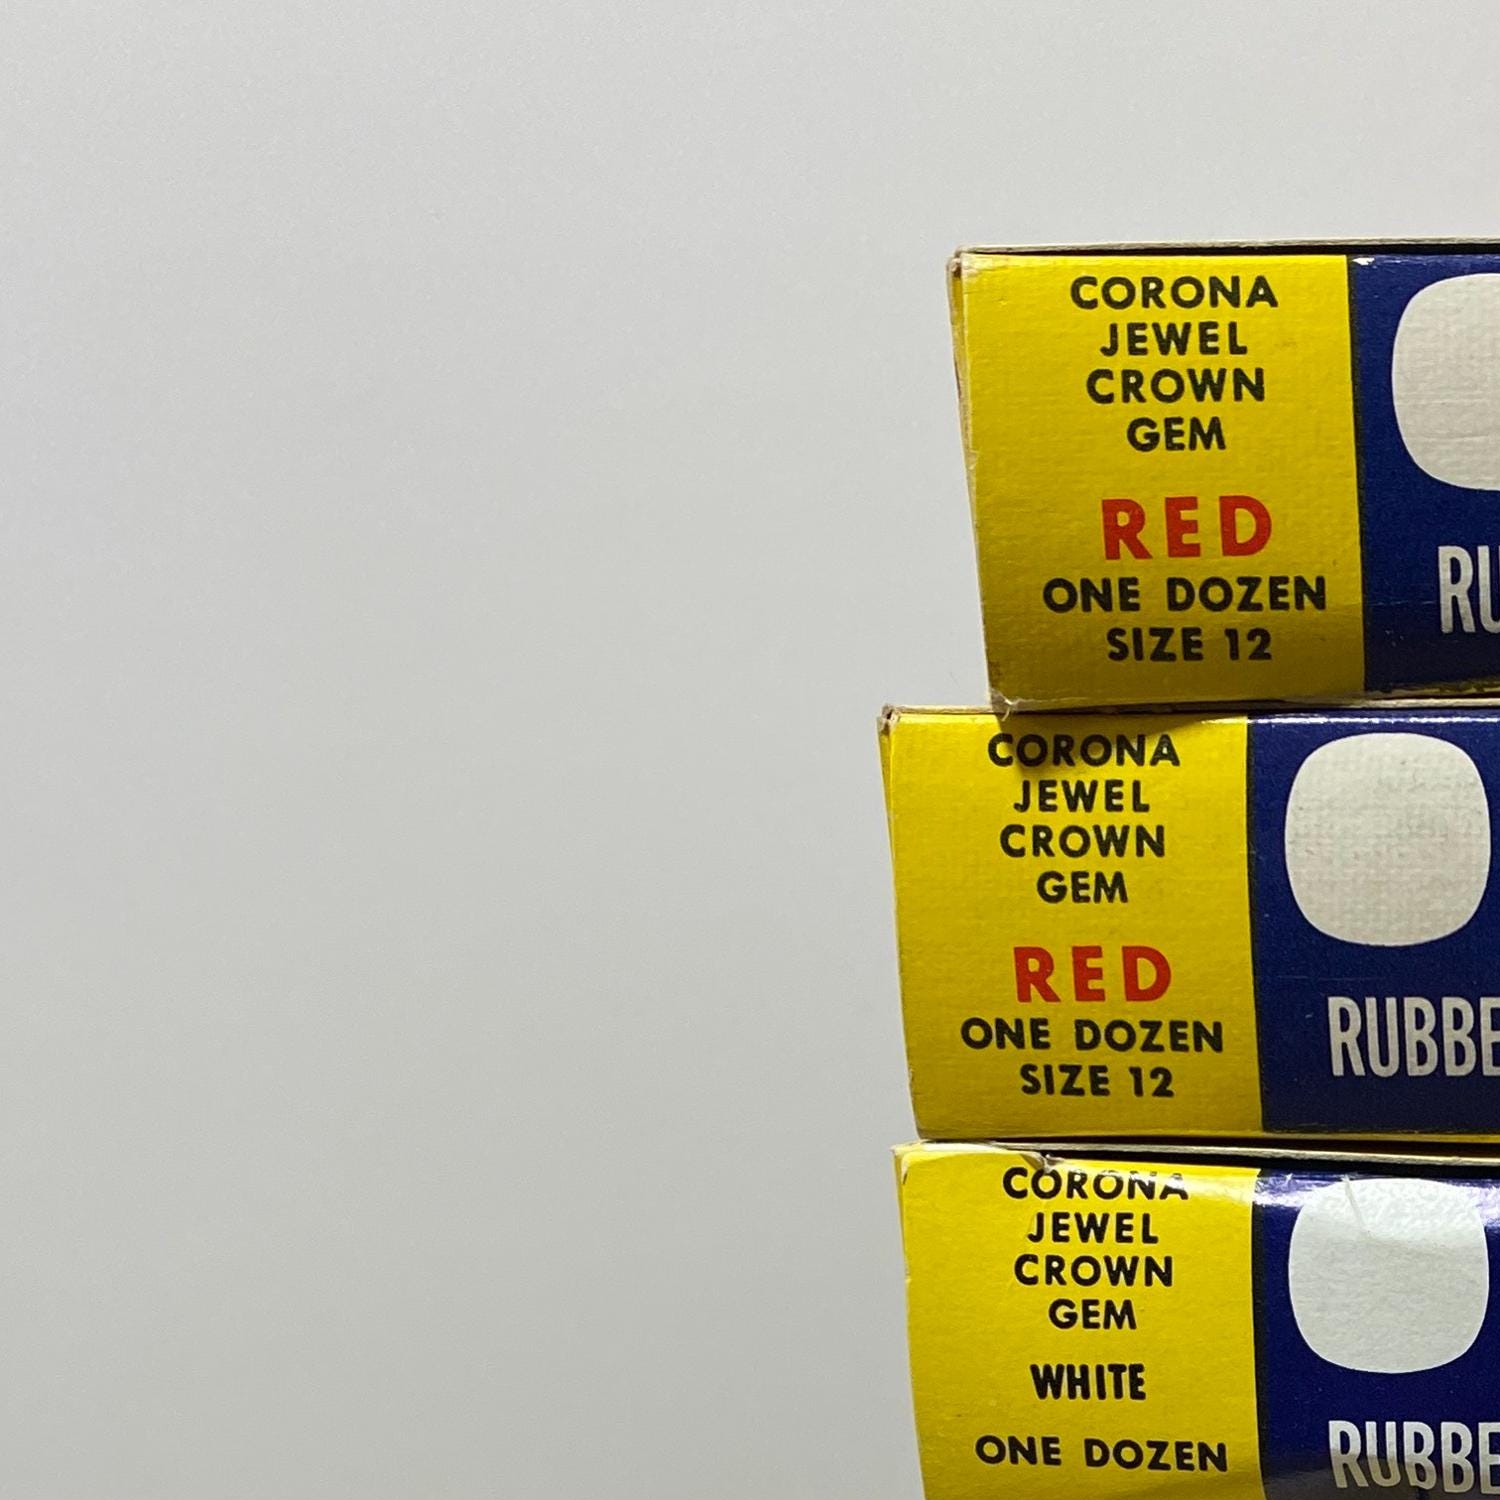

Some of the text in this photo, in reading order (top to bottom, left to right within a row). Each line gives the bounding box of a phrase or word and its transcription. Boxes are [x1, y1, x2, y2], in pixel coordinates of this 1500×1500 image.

[1070, 275, 1278, 310] CORONA
[1100, 322, 1248, 356] JEWEL
[1086, 368, 1266, 404] CROWN
[1126, 416, 1226, 452] GEM
[1101, 495, 1273, 561] RED
[1042, 576, 1327, 613] ONE DOZEN
[1107, 627, 1272, 662] SIZE 12
[987, 732, 1181, 768] CORONA
[1013, 779, 1150, 813] JEWEL
[999, 824, 1166, 858] CROWN
[1036, 870, 1128, 904] GEM
[1013, 945, 1173, 1003] RED
[960, 1018, 1223, 1054] ONE DOZEN
[1020, 1064, 1174, 1097] SIZE 12
[1001, 1165, 1189, 1201] CORONA
[1027, 1212, 1159, 1245] JEWEL
[1014, 1255, 1173, 1287] CROWN
[1047, 1298, 1137, 1330] GEM
[1029, 1363, 1146, 1400] WHITE
[975, 1434, 1228, 1472] ONE DOZEN
